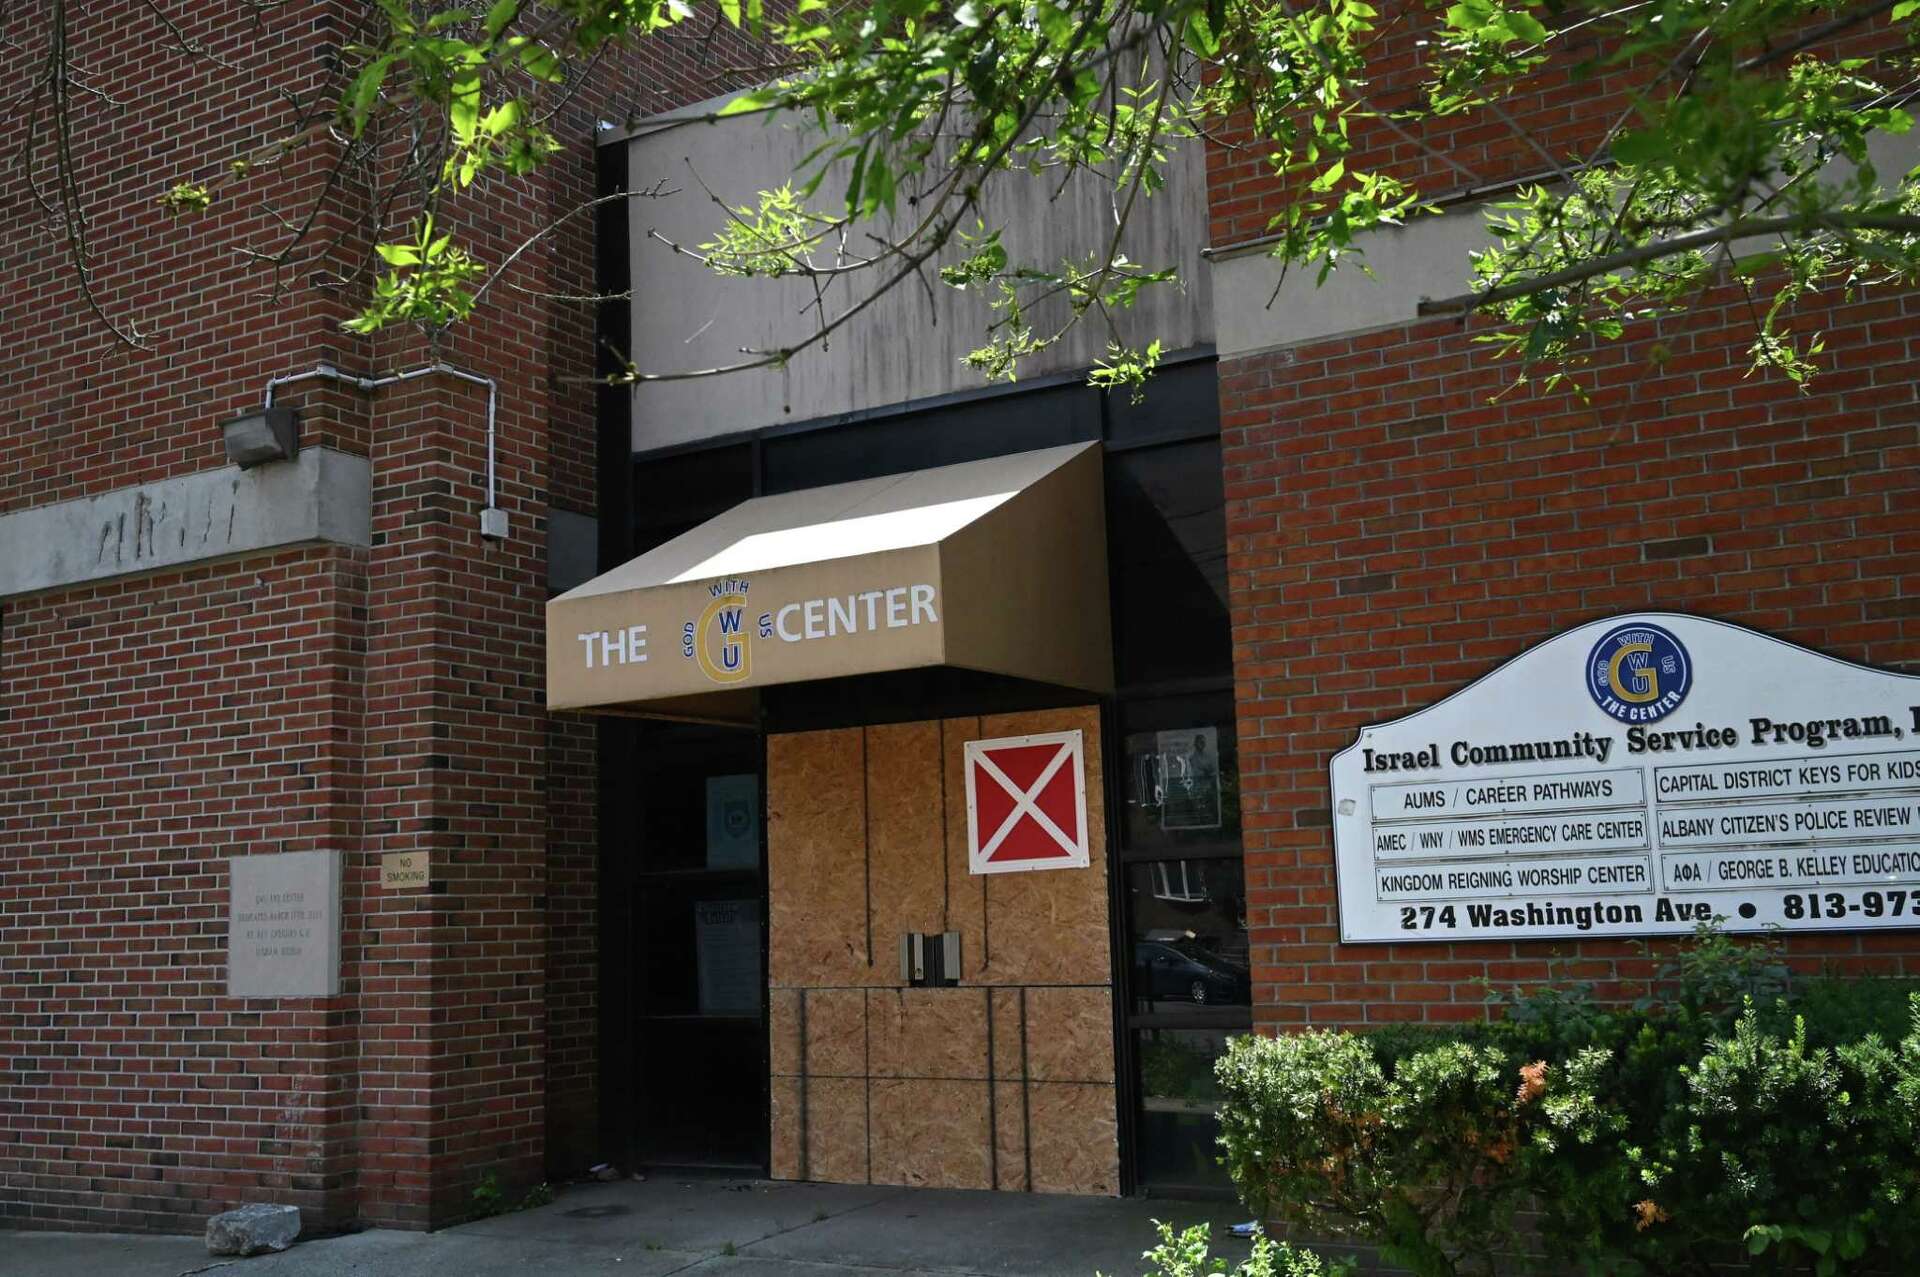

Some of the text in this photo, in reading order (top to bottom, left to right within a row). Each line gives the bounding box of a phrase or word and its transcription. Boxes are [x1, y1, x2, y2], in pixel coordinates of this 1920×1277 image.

[709, 580, 749, 597] WITH
[578, 584, 938, 668] THE CENTER
[683, 622, 694, 657] GOD
[759, 613, 772, 638] US
[1617, 632, 1654, 645] WITH
[1597, 660, 1608, 686] GOD
[1662, 655, 1676, 674] US
[1601, 691, 1680, 720] THE CENTER
[1363, 744, 1440, 772] Israel
[1451, 731, 1612, 766] Community
[1627, 722, 1736, 752] Service
[1750, 715, 1900, 747] Program,
[1660, 773, 1718, 793] CAPITAL
[1724, 769, 1792, 789] DISTRICT
[1799, 765, 1841, 785] KEYS
[1848, 763, 1880, 782] FOR
[1404, 790, 1446, 809] AUMS
[1466, 784, 1527, 806] CAREER
[1533, 779, 1613, 801] PATHWAYS
[1377, 833, 1407, 852] AMEC
[1419, 832, 1444, 849] WNY
[1458, 829, 1485, 847] WMS
[1490, 825, 1557, 845] EMERGENCY
[1562, 823, 1592, 841] CARE
[1597, 820, 1643, 839] CENTER
[1662, 818, 1715, 838] ALBANY
[1721, 813, 1789, 835] CITIZEN'S
[1795, 810, 1848, 830] POLICE
[1854, 806, 1911, 828] REVIEW
[387, 870, 425, 882] SMOKING
[400, 857, 412, 868] NO
[1718, 859, 1774, 880] GEORGE
[1779, 858, 1792, 877] B.
[1798, 855, 1847, 876] KELLEY
[1853, 851, 1920, 874] EDUCATIO
[1382, 865, 1645, 893] KINGDOM REIGNING WORSHIP CENTER
[1400, 905, 1456, 930] 274
[1467, 902, 1643, 931] Washington
